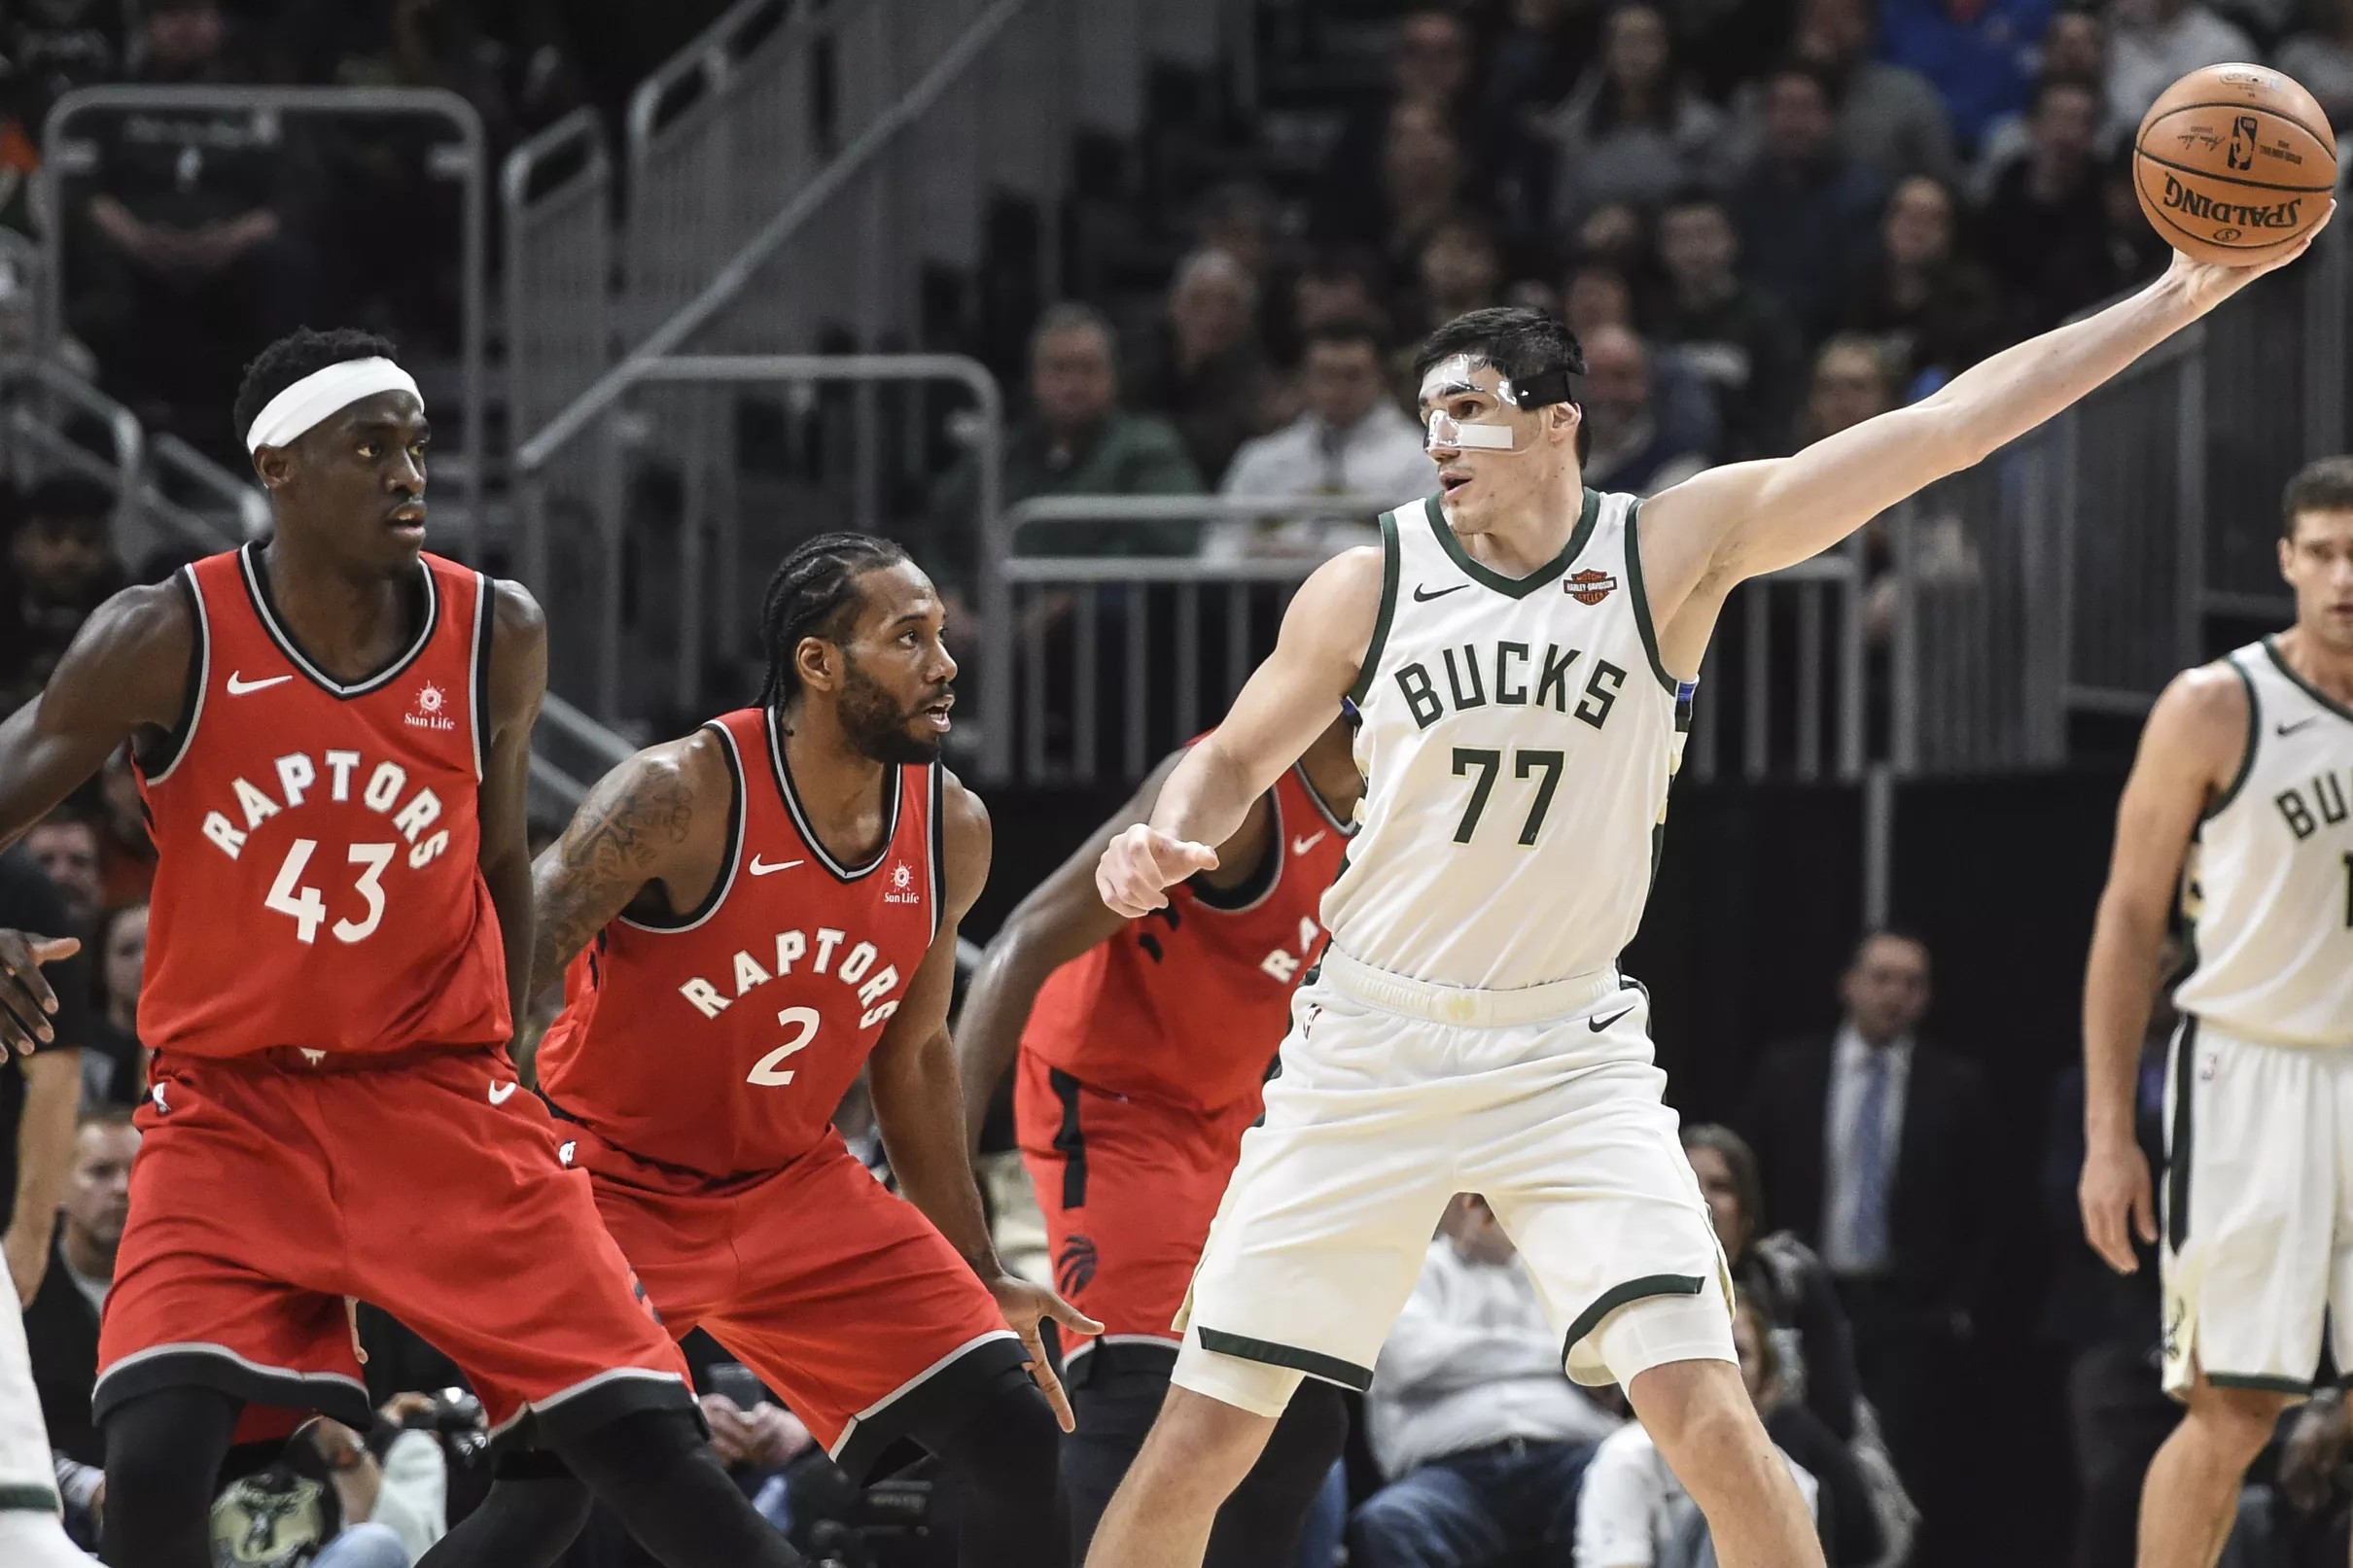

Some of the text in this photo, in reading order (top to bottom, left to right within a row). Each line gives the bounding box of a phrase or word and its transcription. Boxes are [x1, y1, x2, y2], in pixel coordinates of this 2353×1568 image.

[2163, 174, 2301, 228] SPALDING
[404, 713, 456, 730] Sun Life
[1394, 641, 1628, 730] BUCKS
[201, 749, 449, 868] RAPTORS
[1452, 747, 1564, 847] 77
[263, 838, 397, 944] 43
[884, 891, 920, 904] Sun Life
[679, 926, 900, 1030] RAPTORS
[746, 1006, 821, 1086] 2
